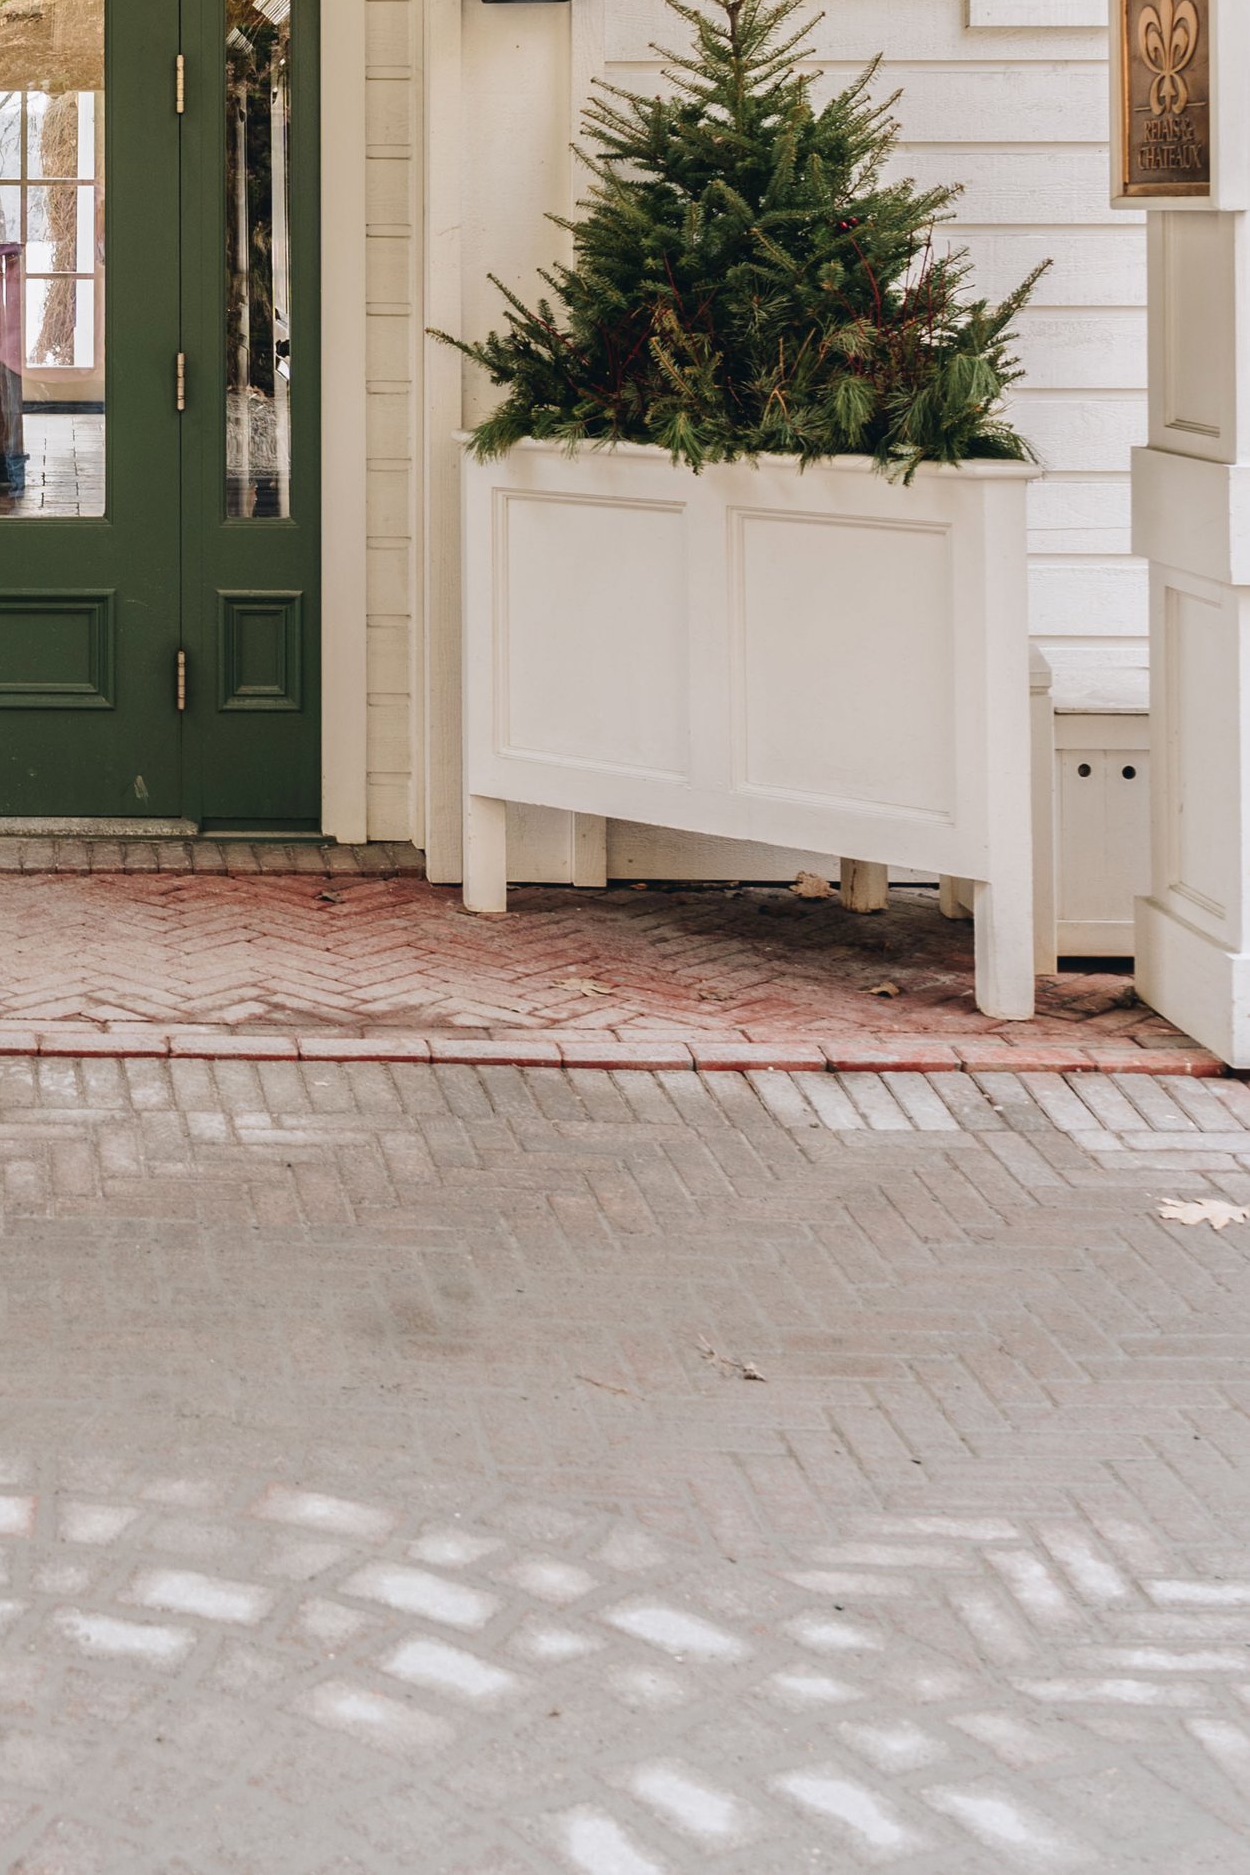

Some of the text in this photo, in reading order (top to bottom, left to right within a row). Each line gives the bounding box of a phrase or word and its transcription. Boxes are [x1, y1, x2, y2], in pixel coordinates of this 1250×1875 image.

[1143, 117, 1195, 142] RELAIS &
[1137, 144, 1202, 170] CHATEAUX
